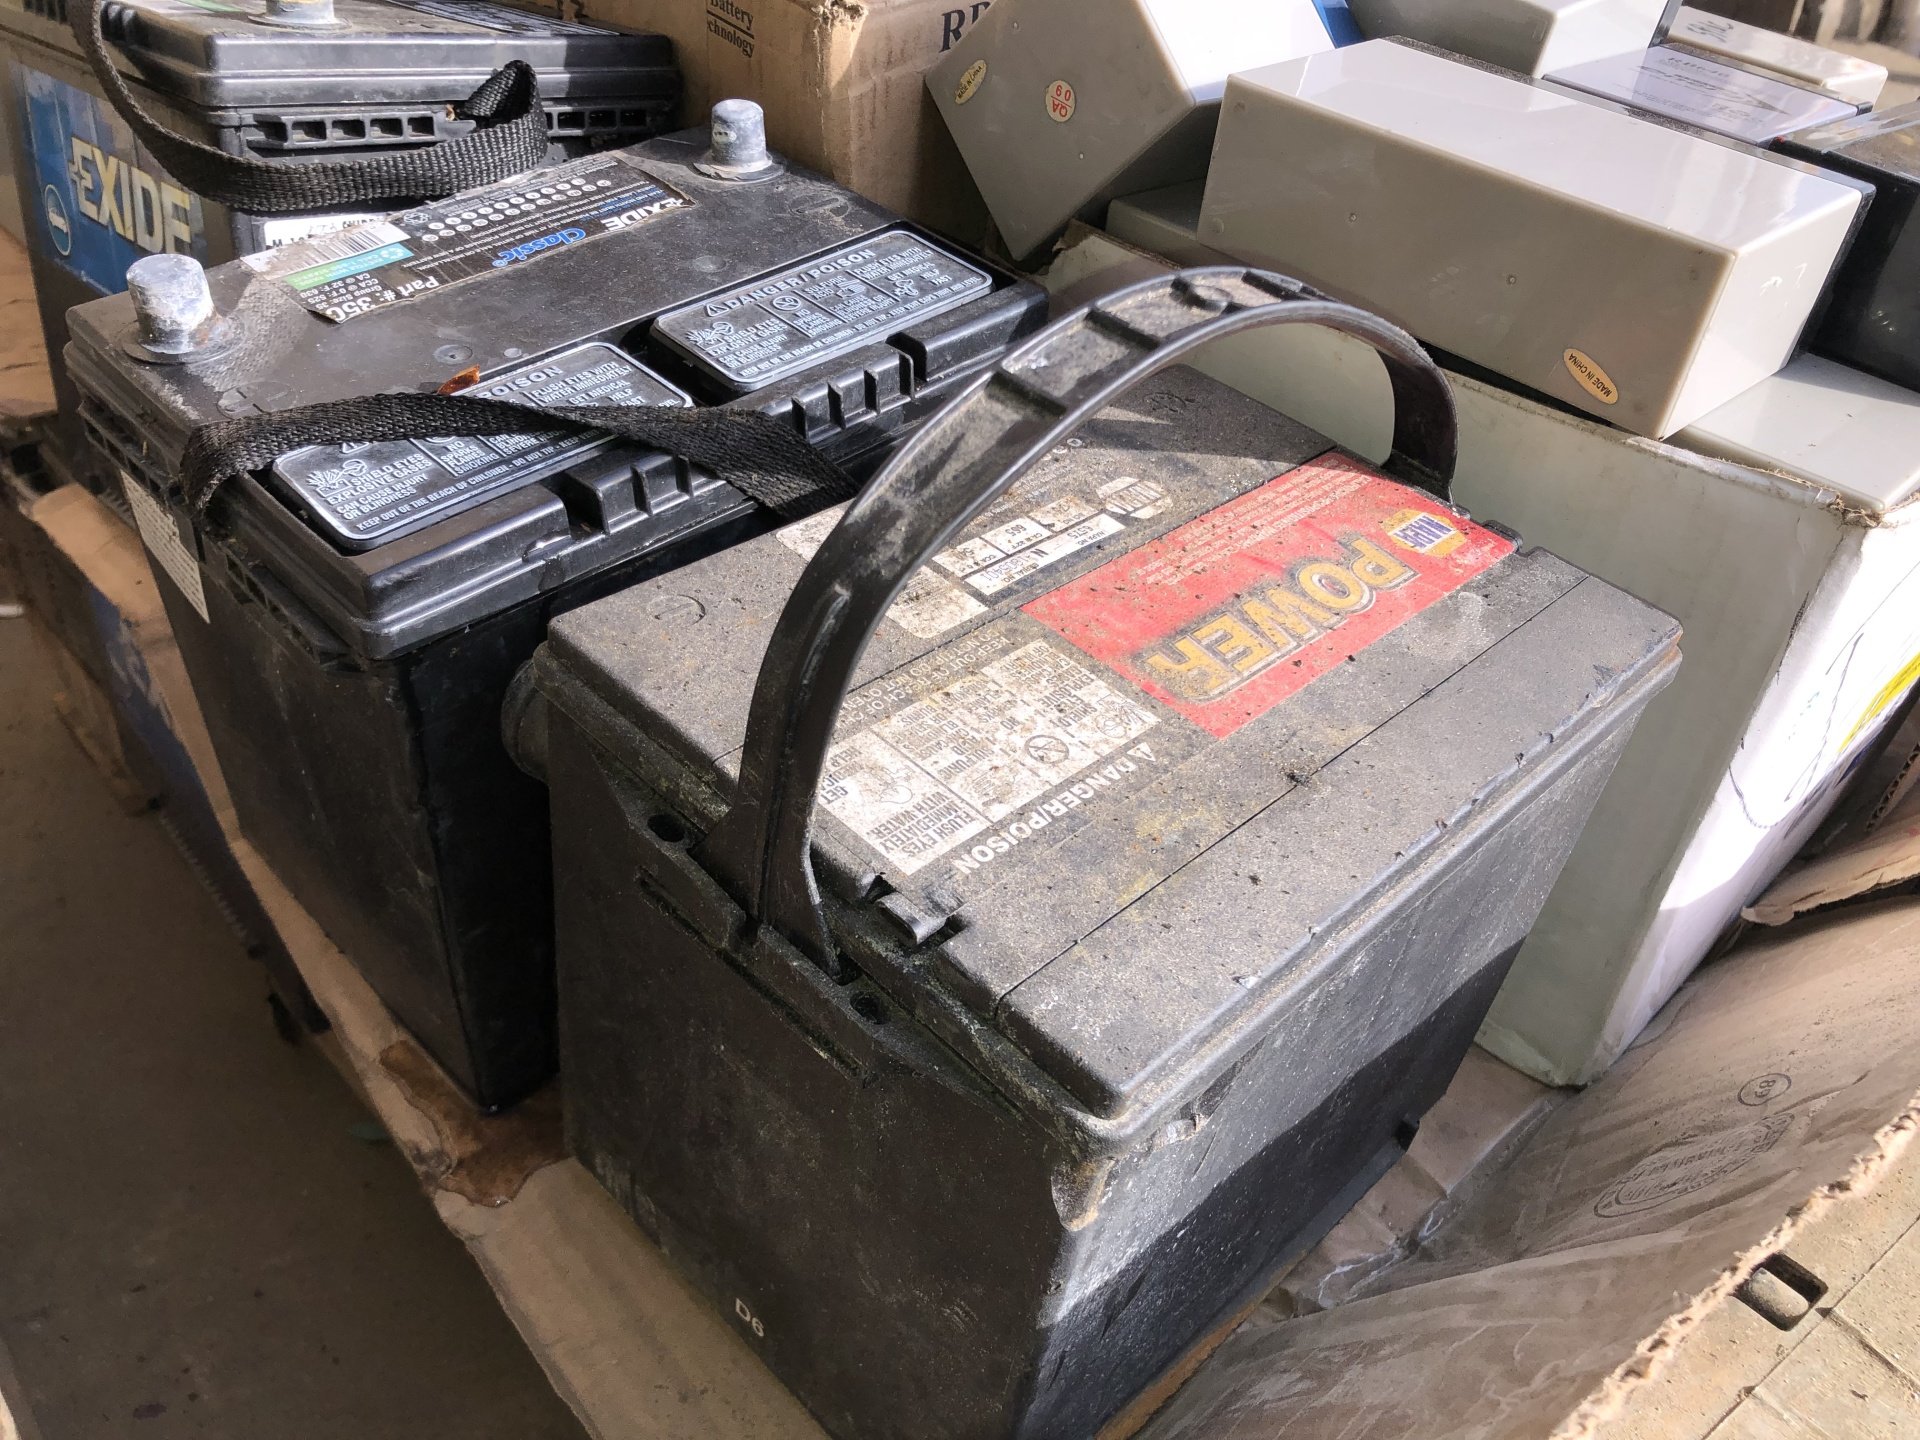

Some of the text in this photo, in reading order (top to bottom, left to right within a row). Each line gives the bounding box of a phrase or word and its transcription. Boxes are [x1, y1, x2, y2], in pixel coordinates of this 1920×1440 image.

[1052, 99, 1067, 118] QA
[69, 136, 191, 255] EXIDE
[599, 196, 687, 230] EXIDE
[853, 246, 922, 275] FLUSH EYES WITH
[392, 275, 442, 296] Part
[803, 275, 846, 294] SULFURIC
[931, 274, 953, 285] FAST
[708, 322, 788, 356] EXPLOSIVE GASES
[722, 317, 781, 342] SHIELD EYES
[530, 360, 620, 397] FLUSH EYES WITH
[537, 364, 635, 404] WATER IMMEDIATELY
[568, 378, 631, 405] GET MEDICAL
[1569, 352, 1612, 398] MADE IN CHINA
[607, 387, 636, 400] HELP
[439, 444, 480, 462] SPARKS
[444, 440, 466, 451] NO
[446, 449, 487, 468] FLAMES
[349, 453, 425, 485] SHIELD EYES
[452, 452, 501, 474] SMOKING
[324, 458, 434, 504] EXPLOSIVE GASES
[334, 472, 430, 513] CAN CAUSE INJURY
[354, 515, 382, 530] KEEP
[378, 509, 400, 520] OUT
[396, 503, 414, 513] OF
[409, 496, 431, 508] THE
[426, 485, 459, 501] REACH
[454, 480, 471, 490] OF
[466, 464, 512, 485] CHILDREN
[511, 458, 528, 467] DO
[524, 451, 544, 462] NOT
[538, 446, 558, 456] TIP
[341, 486, 418, 519] OR BLINDNESS
[1394, 513, 1455, 555] NAPA
[1146, 535, 1421, 698] POWER
[1036, 671, 1095, 710] EXPLOSIVE
[998, 715, 1022, 731] NO
[1056, 701, 1098, 729] SHIELD
[949, 734, 982, 756] ACID
[936, 743, 996, 782] SULFURIC
[817, 784, 850, 805] GET
[865, 789, 950, 844] WITH WATER.
[876, 798, 963, 854] IMMEDIATELY
[899, 808, 976, 859] FLUSH EYES
[735, 1297, 764, 1337] D6
